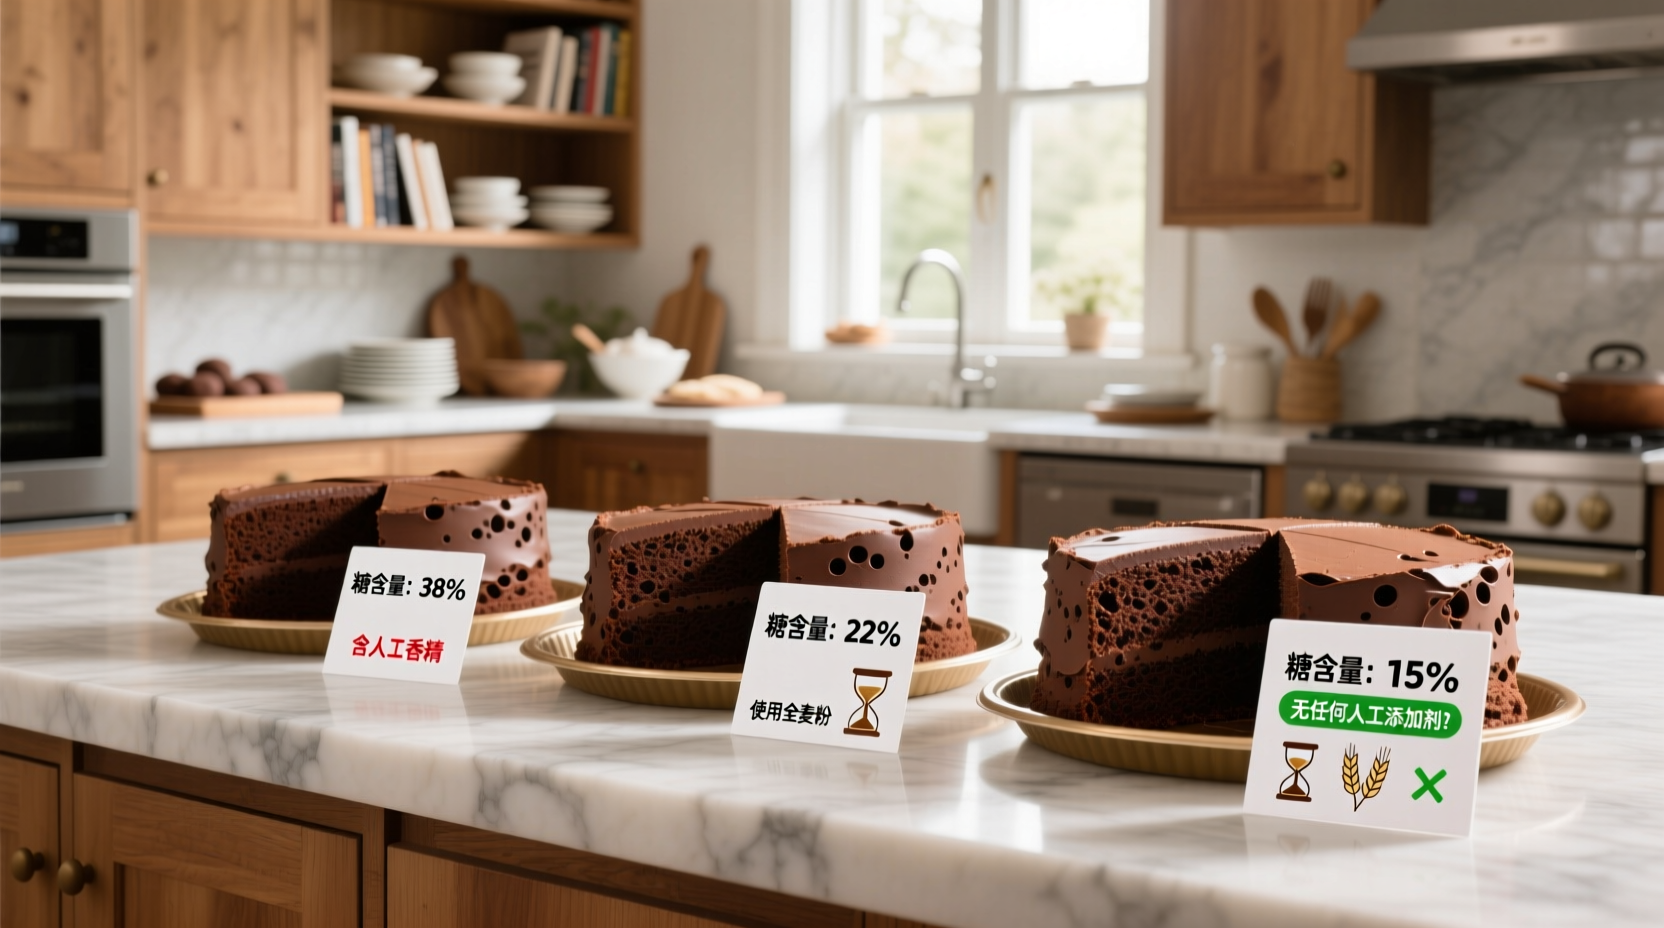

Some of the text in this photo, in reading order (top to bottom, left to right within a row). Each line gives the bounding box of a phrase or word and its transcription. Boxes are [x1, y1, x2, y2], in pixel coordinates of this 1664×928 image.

[352, 634, 444, 663] 含人工香精
[750, 699, 832, 727] 使用全麦粉
